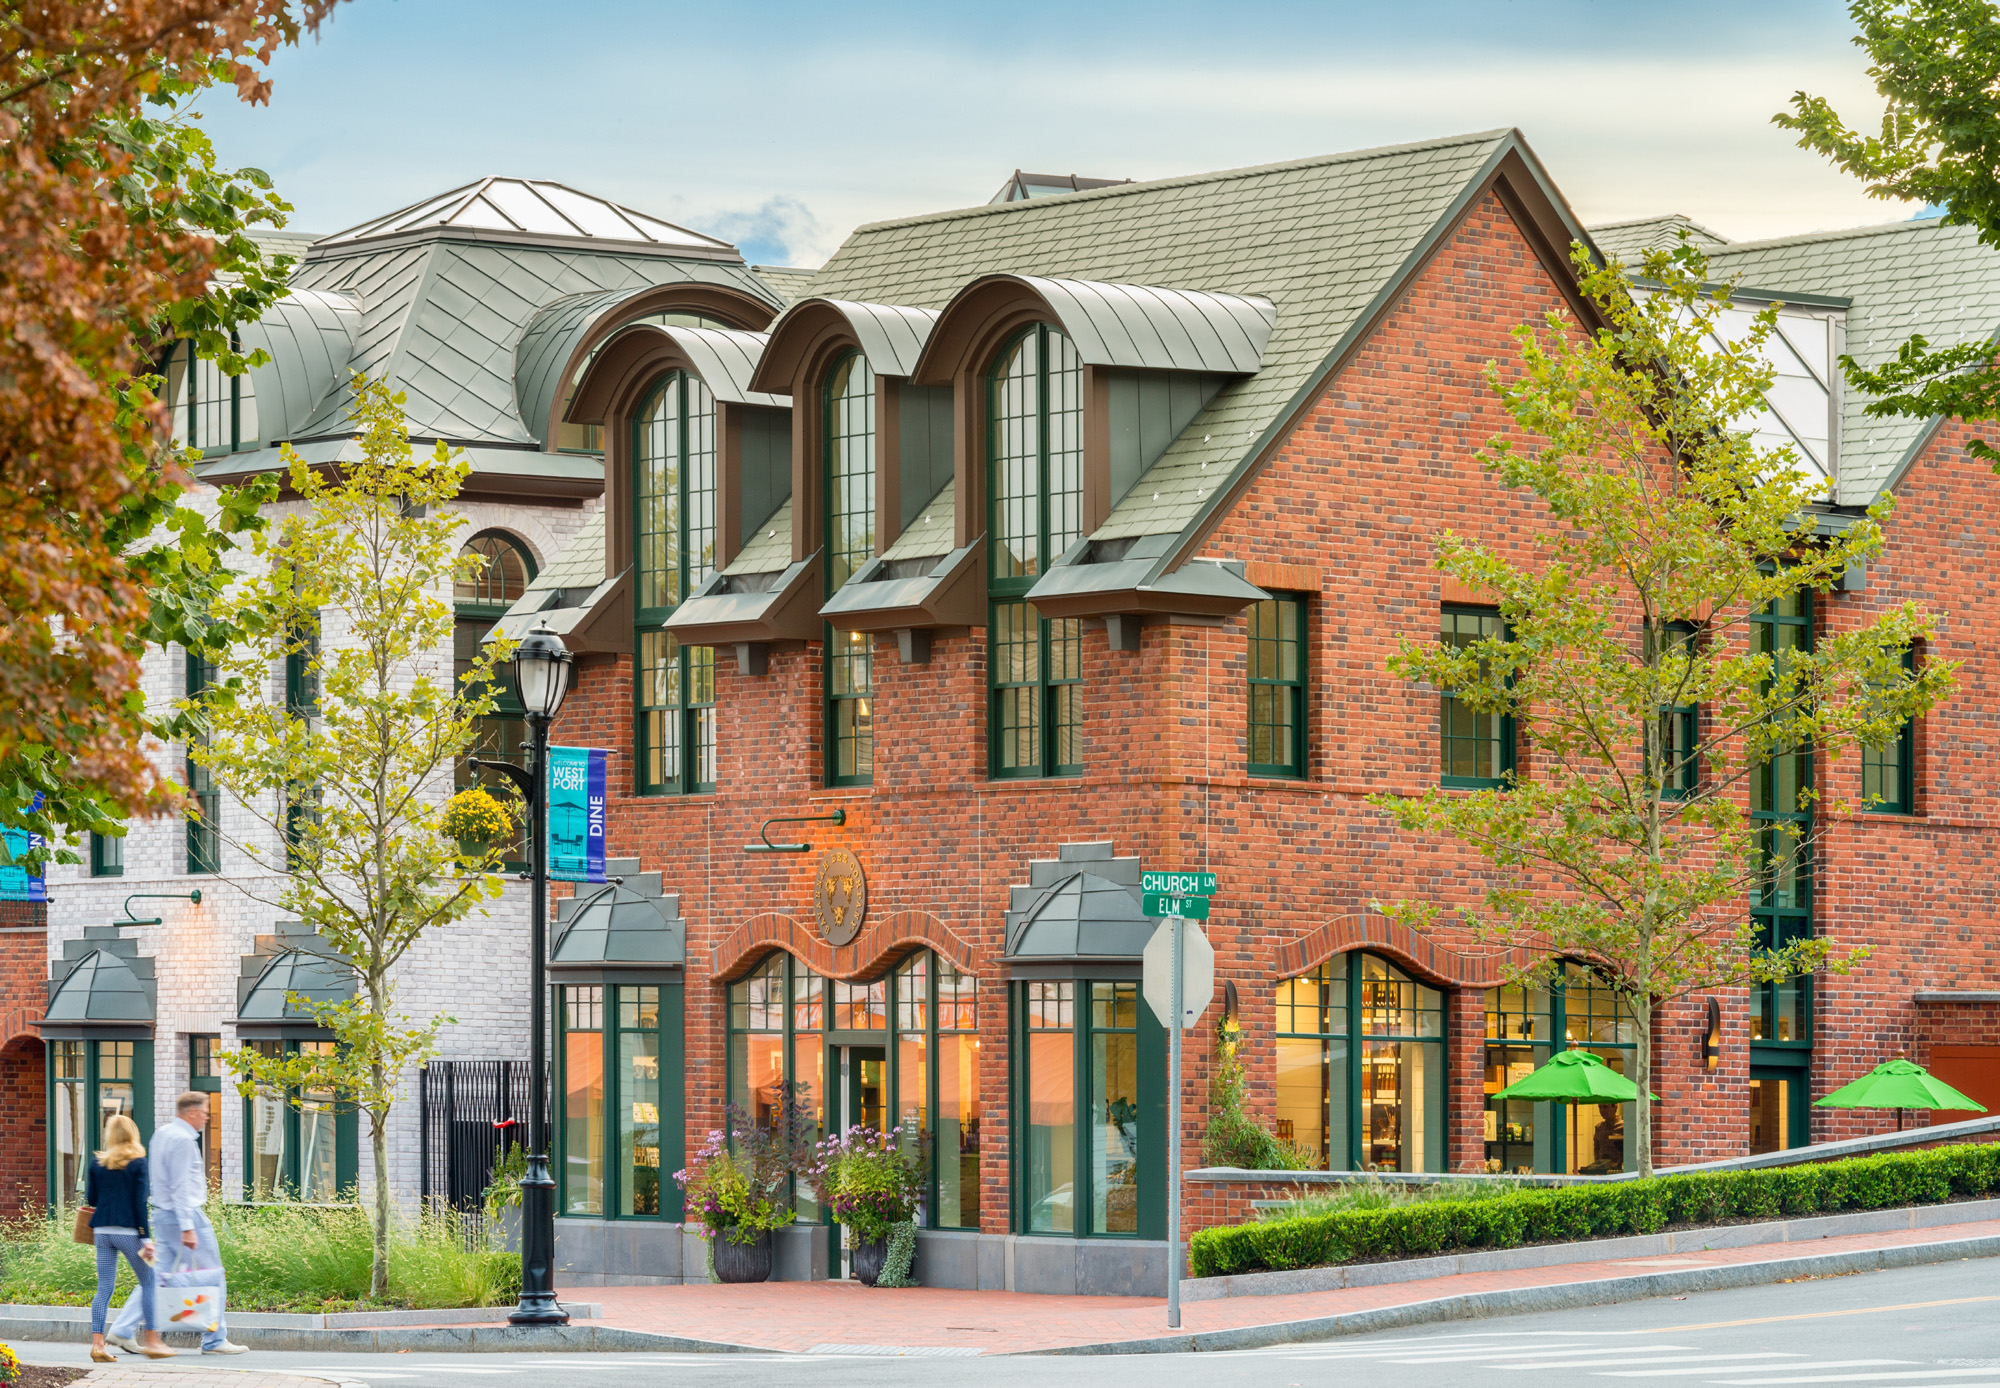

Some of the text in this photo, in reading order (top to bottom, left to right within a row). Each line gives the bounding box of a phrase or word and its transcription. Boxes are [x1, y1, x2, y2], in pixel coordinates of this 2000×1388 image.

[552, 766, 585, 779] WEST
[552, 778, 585, 791] PORT
[589, 796, 603, 837] DINE
[1142, 874, 1215, 892] CHURCH LN
[815, 852, 863, 935] SAVANNAH BEE COMPANY
[1159, 897, 1192, 915] ELM ST
